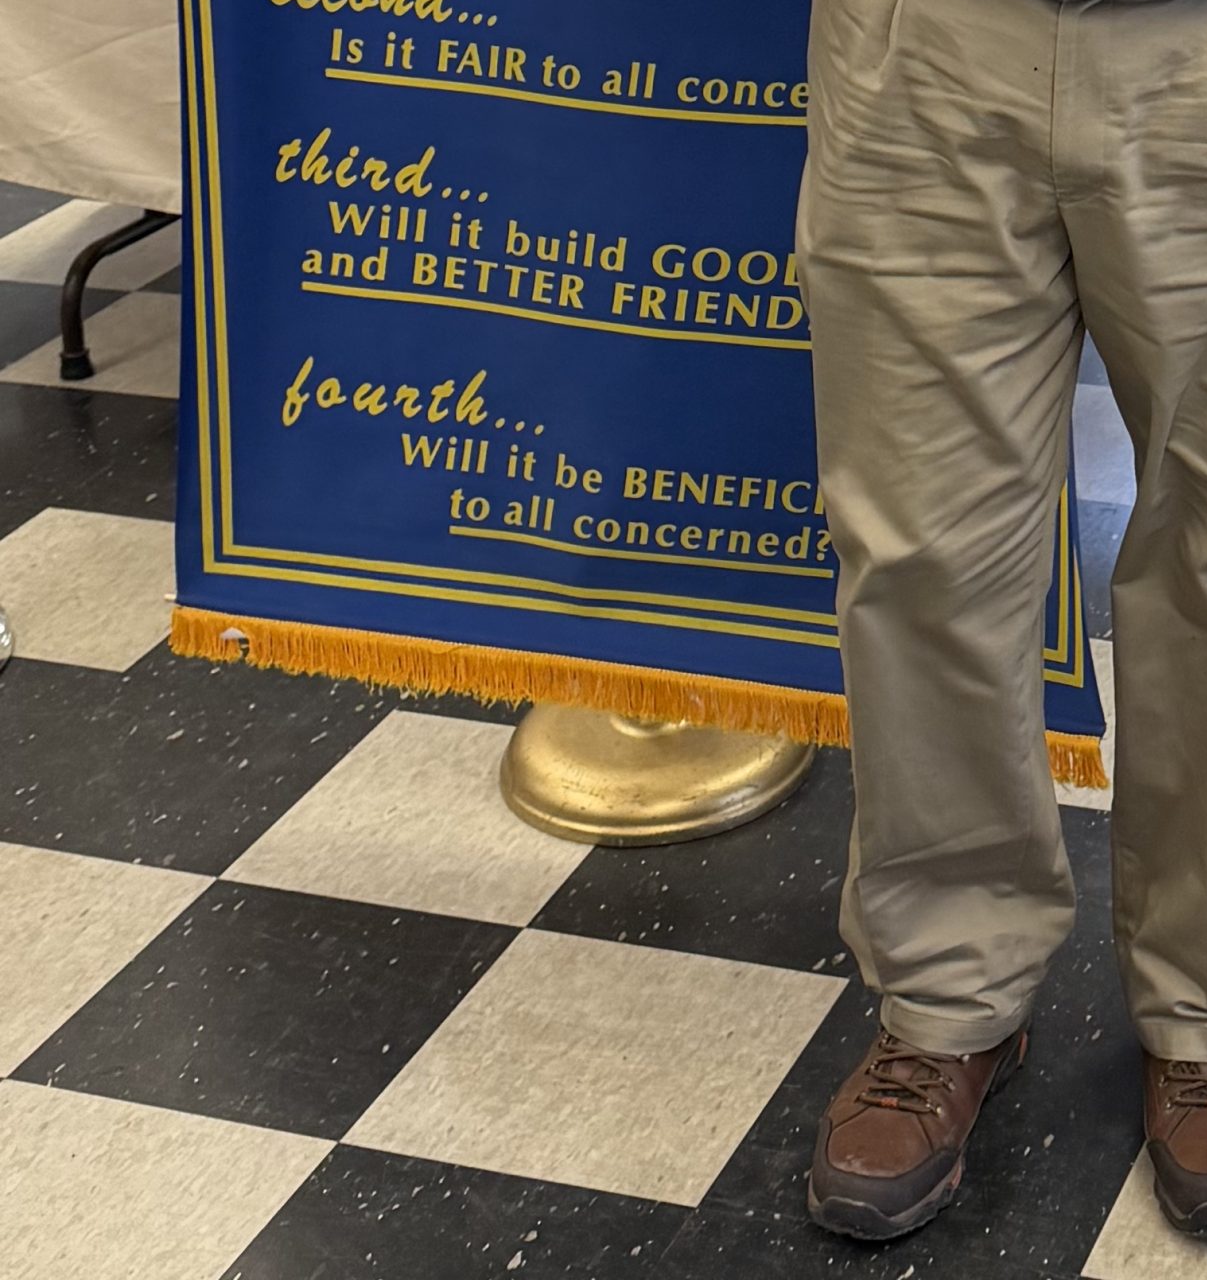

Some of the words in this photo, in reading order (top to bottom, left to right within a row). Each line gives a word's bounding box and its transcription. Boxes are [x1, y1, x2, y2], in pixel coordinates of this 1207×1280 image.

[331, 28, 362, 64] Is
[384, 32, 413, 70] it
[437, 40, 526, 82] FAIR
[543, 57, 581, 89] to
[602, 63, 656, 99] all
[329, 202, 426, 243] Will
[449, 213, 481, 250] it
[505, 221, 626, 272] build
[301, 247, 388, 281] and
[412, 253, 584, 309] BETTER
[611, 282, 811, 331] FRIEND
[401, 434, 489, 474] Will
[507, 446, 535, 481] it
[555, 454, 602, 493] be
[450, 490, 490, 521] to
[503, 496, 554, 531] all
[573, 516, 832, 562] concerned?
